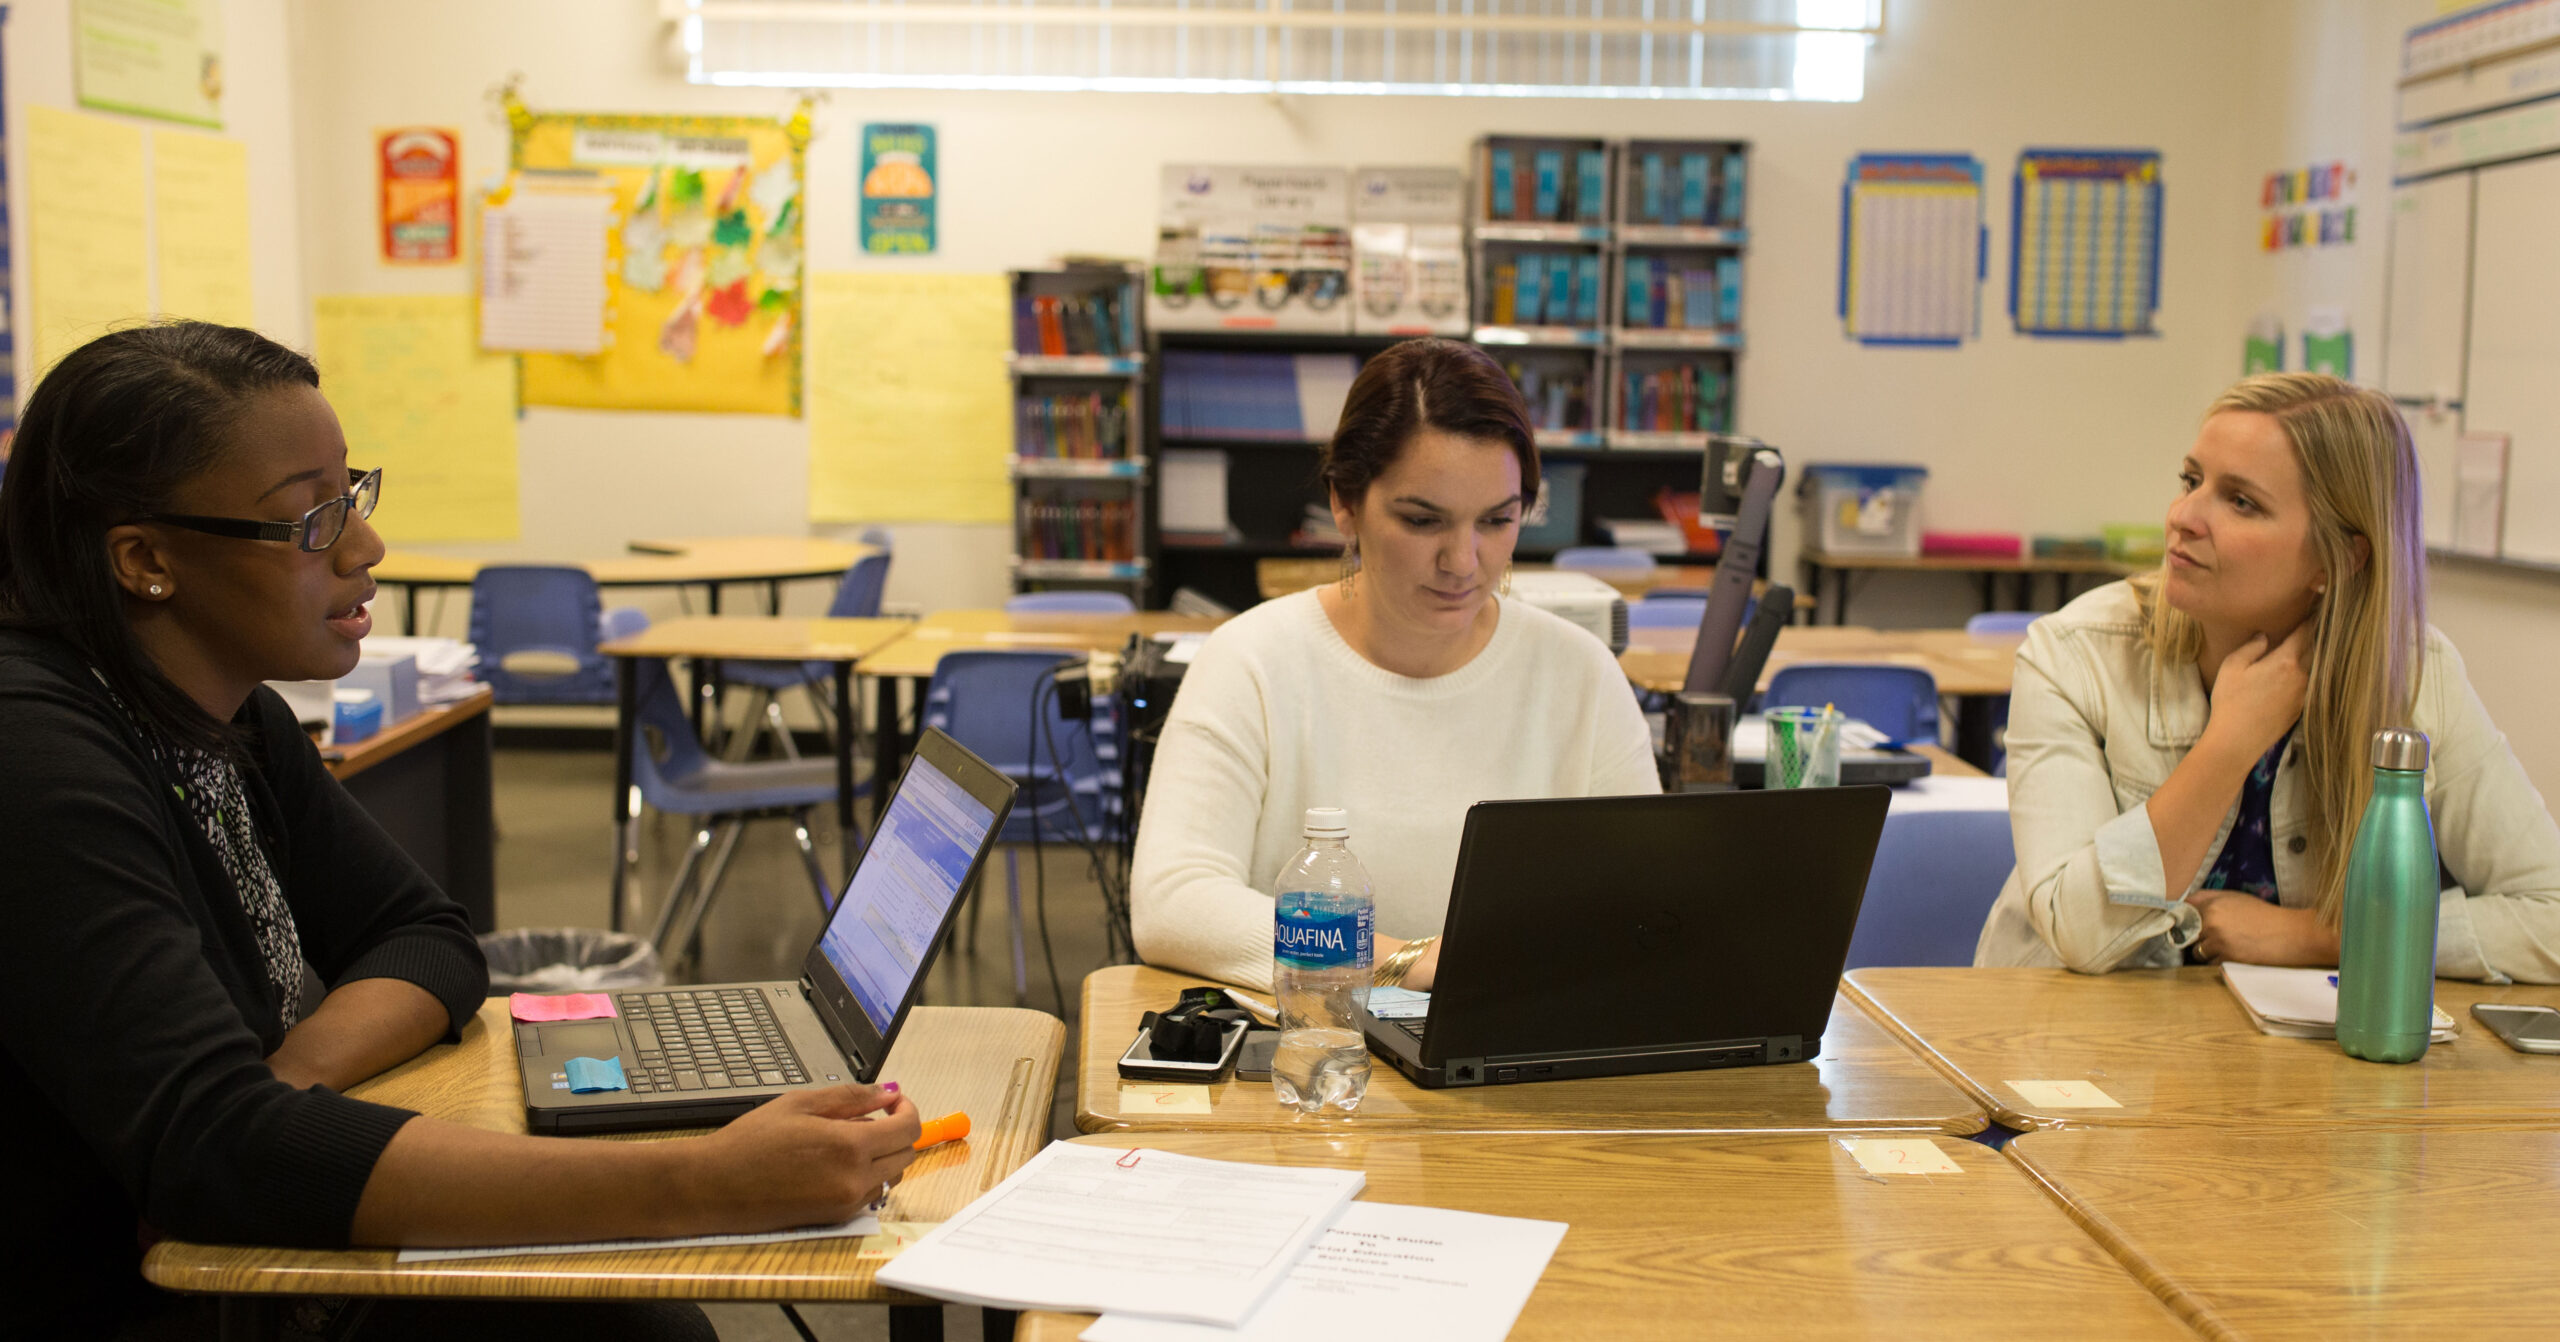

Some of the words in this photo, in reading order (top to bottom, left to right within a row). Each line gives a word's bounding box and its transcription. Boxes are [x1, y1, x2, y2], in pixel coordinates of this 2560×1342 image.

[1275, 920, 1345, 952] AQUAFINA
[1888, 1149, 1921, 1164] 2
[1326, 1228, 1390, 1241] Parent's
[1397, 1236, 1443, 1246] Guide
[1318, 1253, 1389, 1266] Services
[1353, 1249, 1435, 1262] Education
